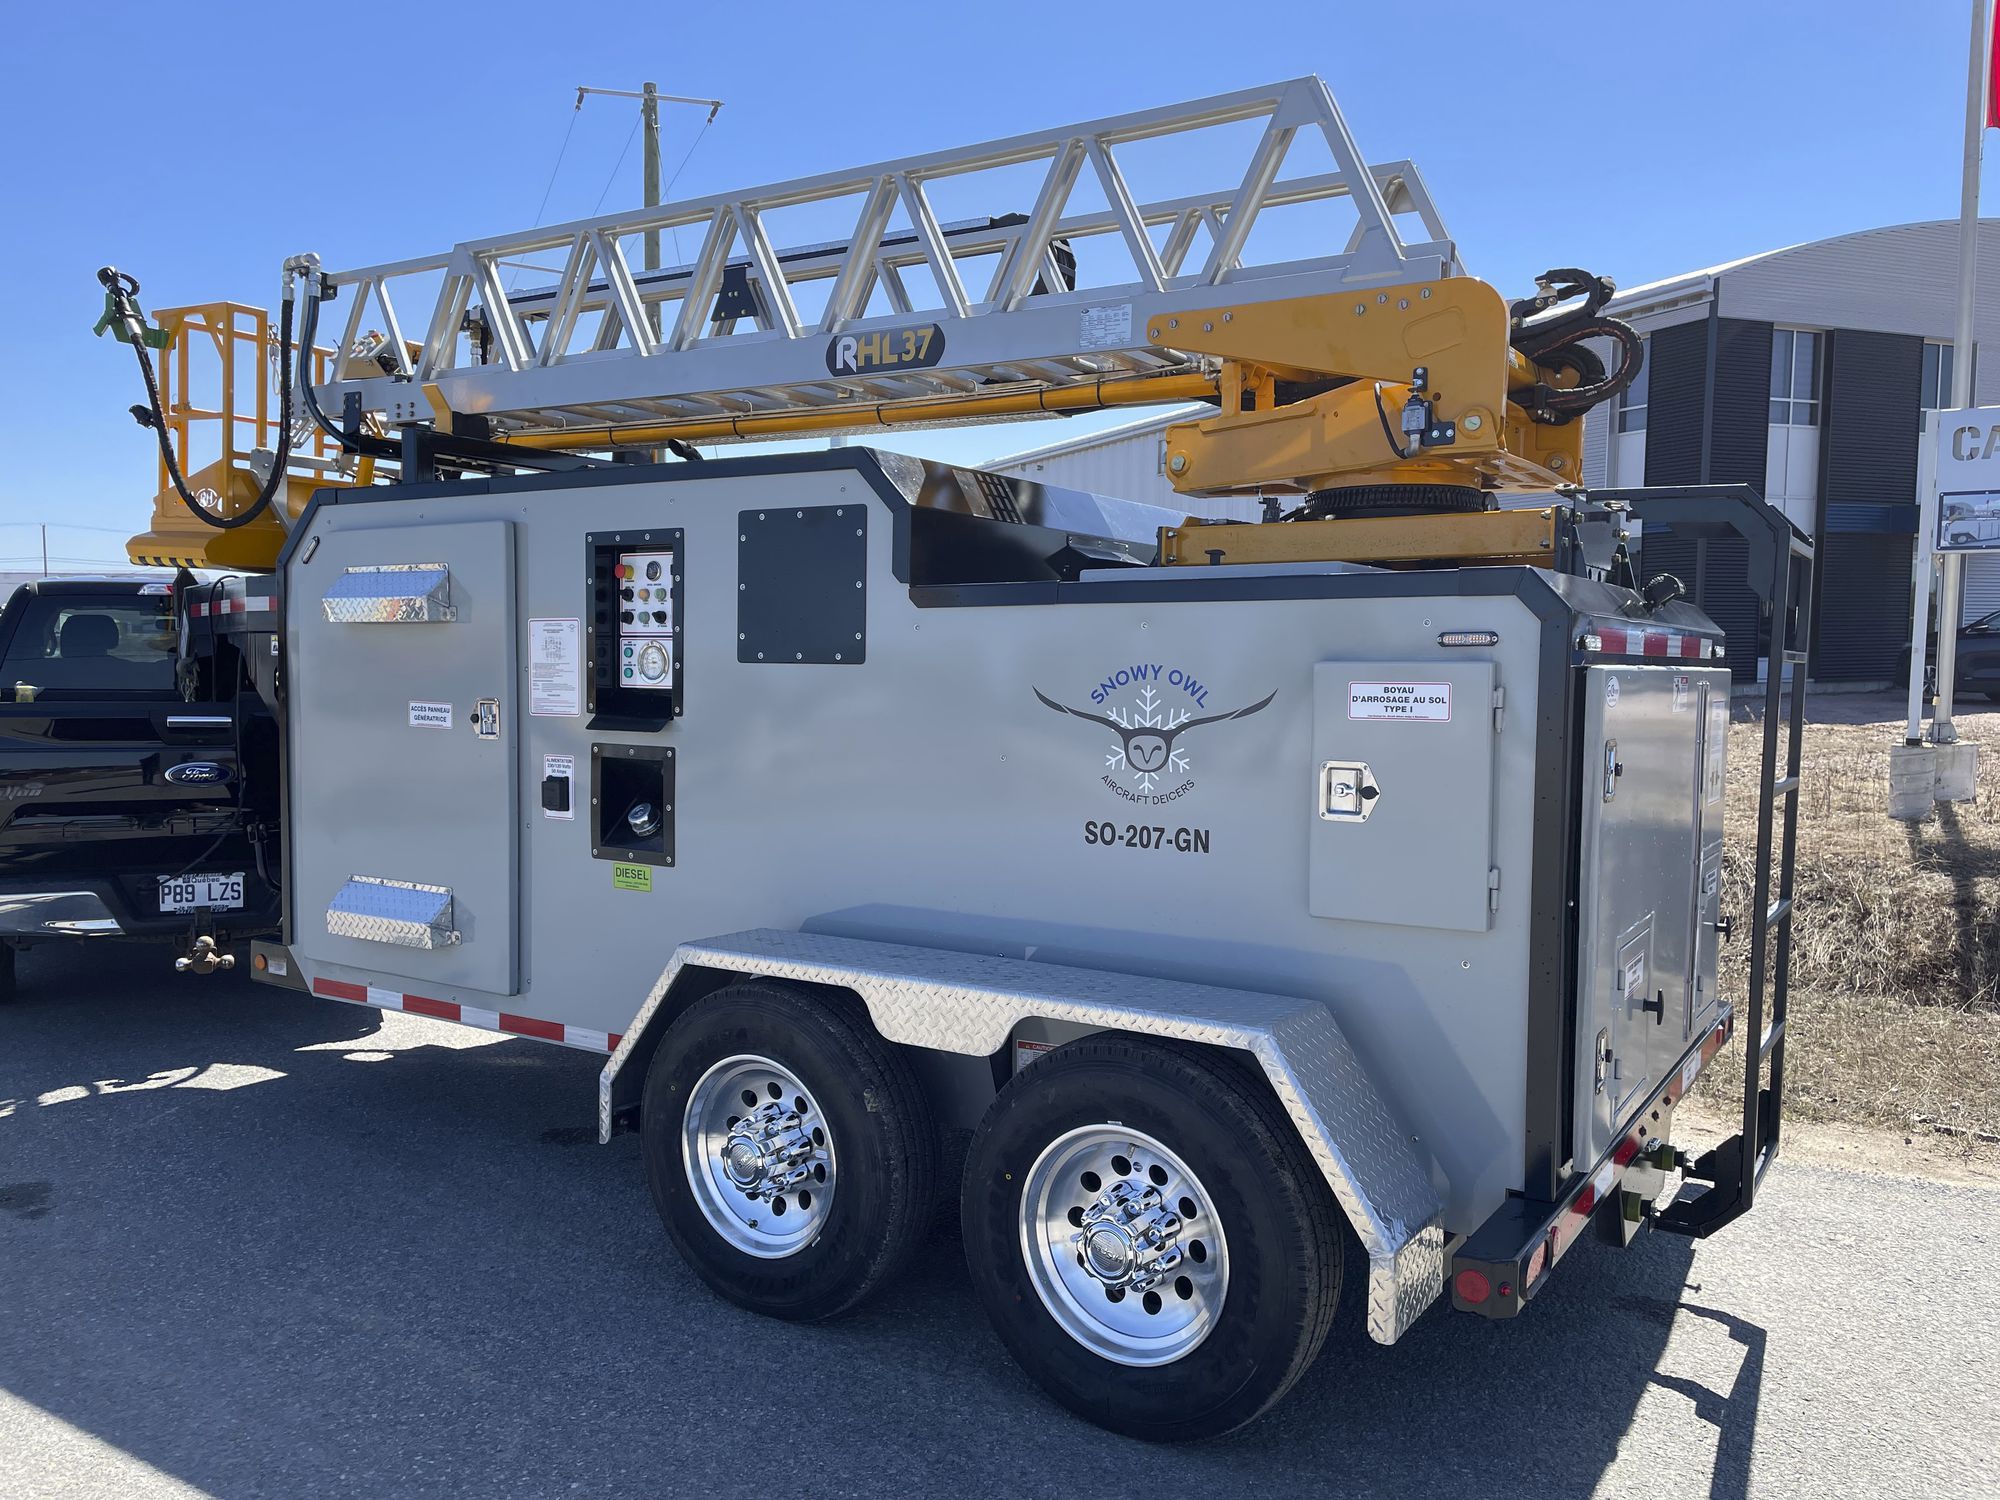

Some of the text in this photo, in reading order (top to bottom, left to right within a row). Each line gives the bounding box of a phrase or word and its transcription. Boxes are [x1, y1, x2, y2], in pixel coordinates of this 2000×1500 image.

[1091, 664, 1209, 709] SNOWY OWL
[1383, 686, 1415, 694] BOYAU
[1352, 695, 1410, 704] D'ARROSAGE
[1384, 705, 1407, 713] TYPE
[181, 767, 219, 782] Ford
[1101, 774, 1195, 805] AIRCRAFT DEICERS
[1084, 820, 1210, 854] SO-207-GN
[615, 866, 649, 881] DIESEL
[161, 881, 242, 905] P89 LZS
